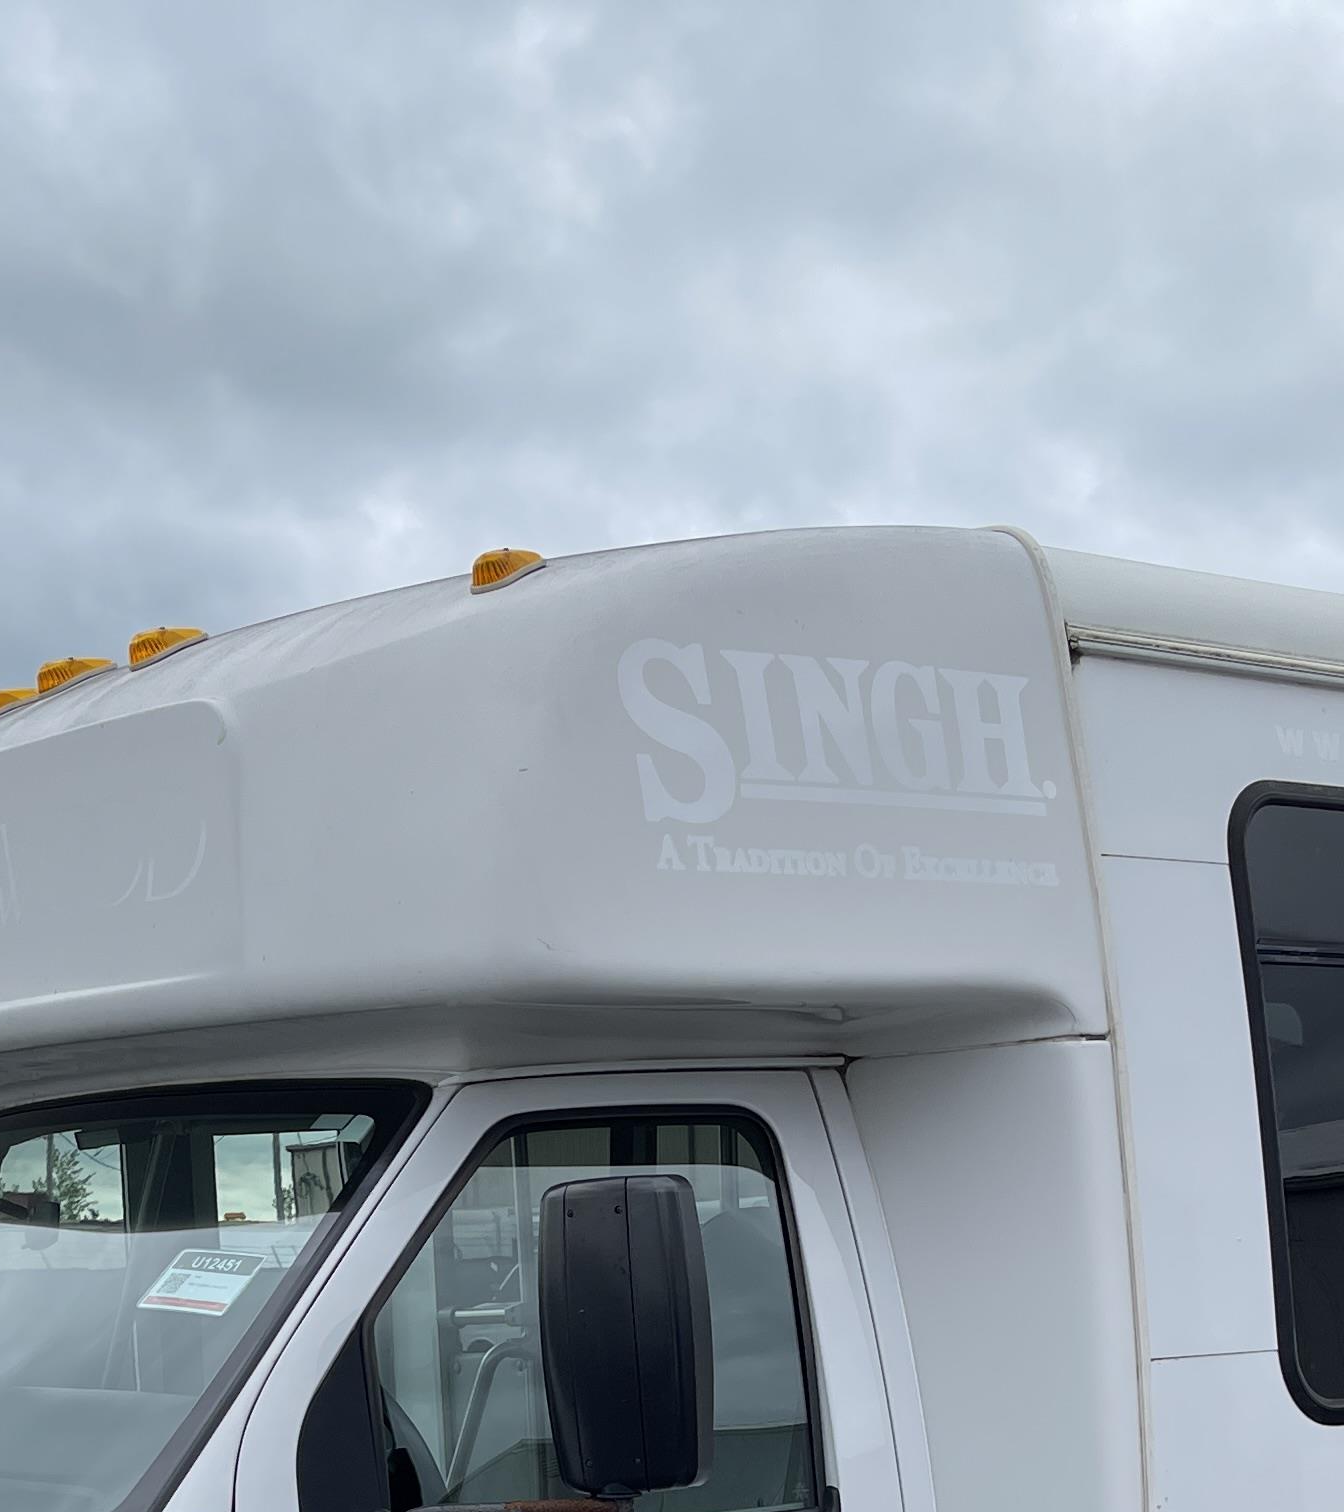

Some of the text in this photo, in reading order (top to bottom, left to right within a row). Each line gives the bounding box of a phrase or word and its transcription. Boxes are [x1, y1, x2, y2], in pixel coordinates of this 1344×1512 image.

[617, 637, 1057, 824] SINGH.
[657, 833, 686, 871] A
[191, 1256, 242, 1271] U12451
